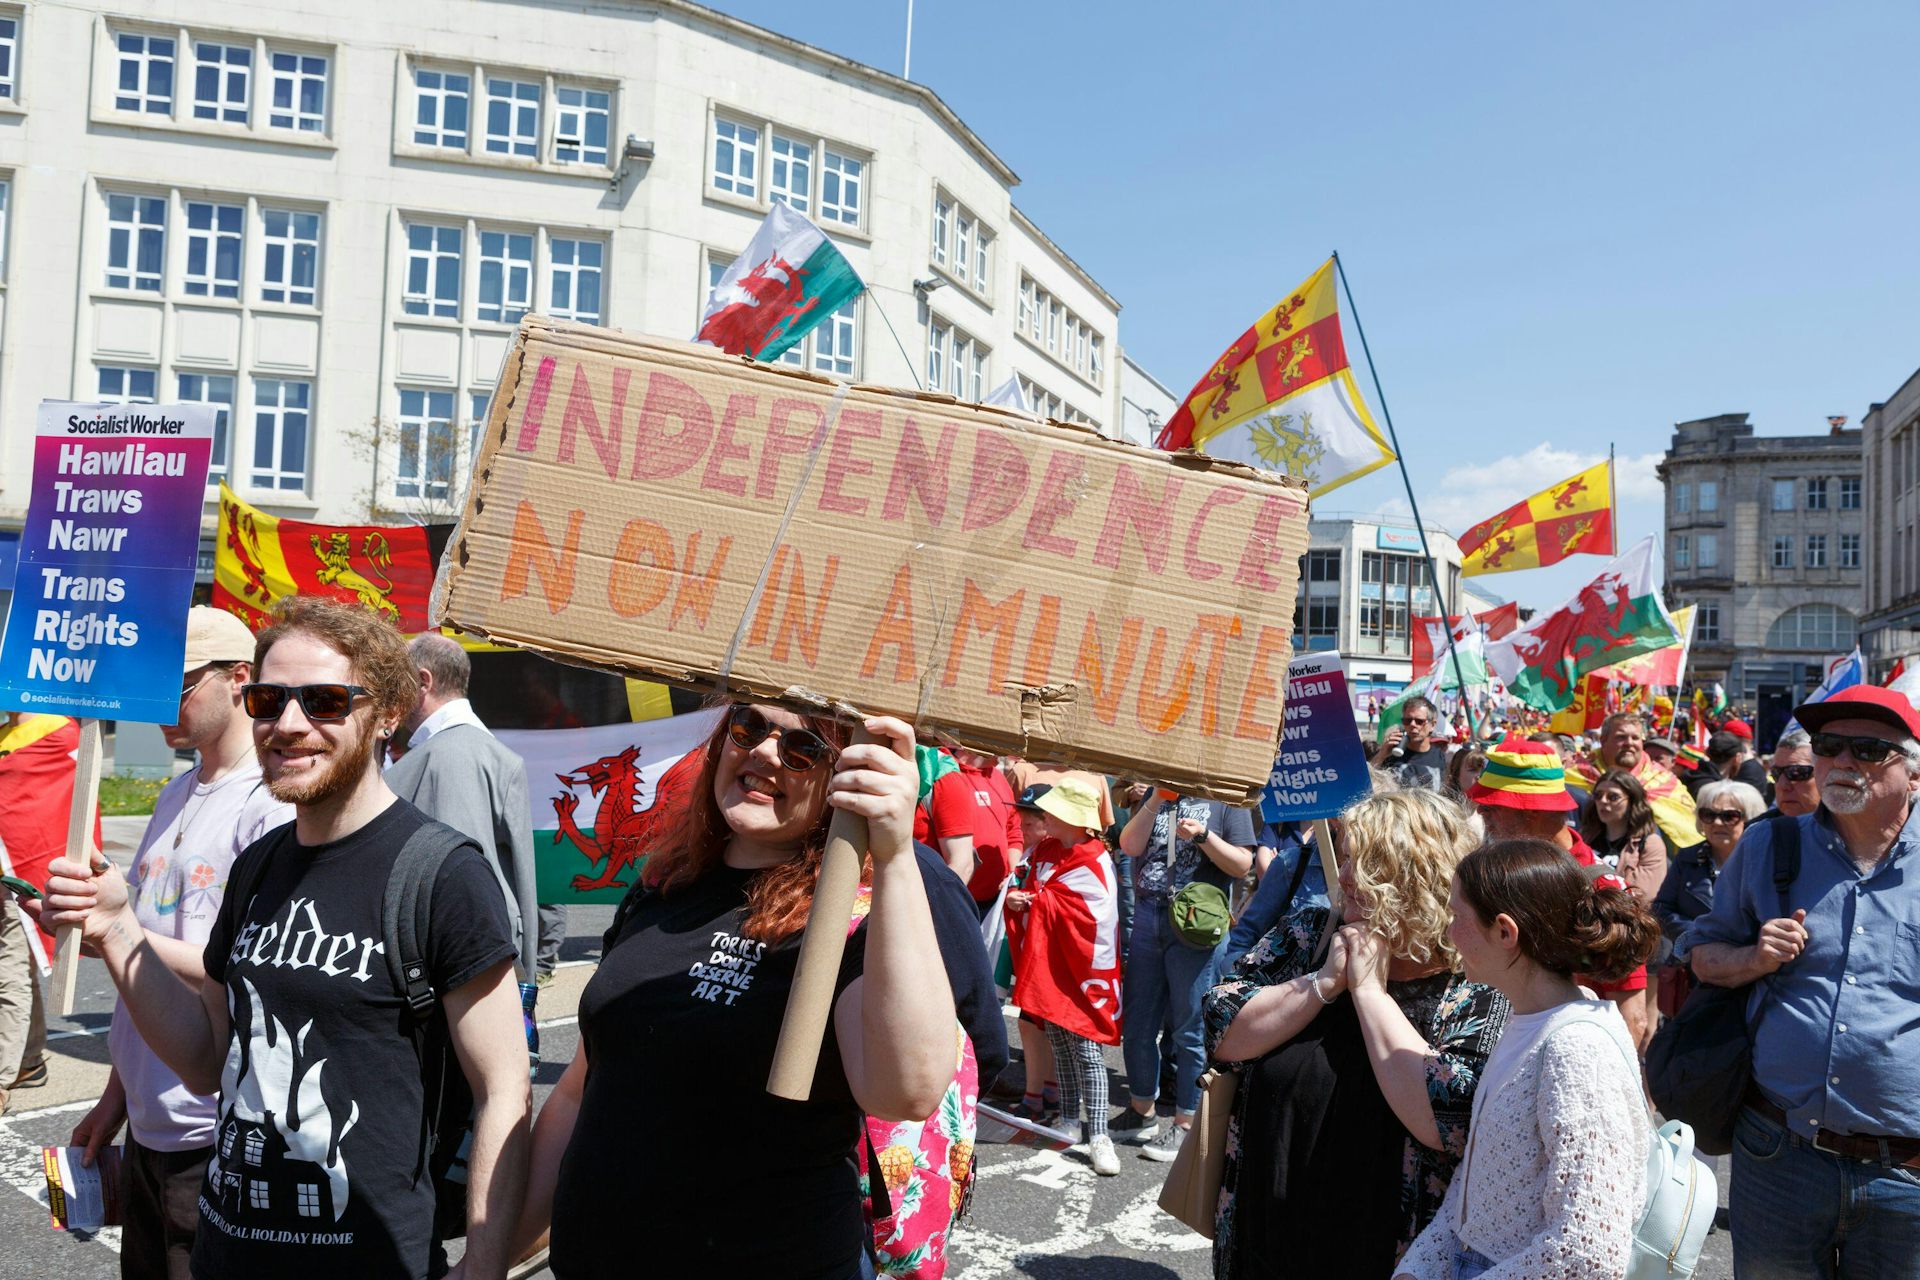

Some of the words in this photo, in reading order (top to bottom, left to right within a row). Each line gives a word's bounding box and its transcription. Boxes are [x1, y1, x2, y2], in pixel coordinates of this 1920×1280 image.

[58, 444, 186, 476] Hawliau
[515, 355, 1299, 593] INDEPENDENCE
[54, 482, 143, 514] Traws
[48, 519, 128, 552] Nawr
[41, 568, 126, 603] Trans
[33, 610, 139, 651] Rights
[500, 499, 734, 631] NOW
[746, 542, 840, 669] IN
[859, 561, 918, 684] A
[941, 577, 1287, 742] MINUTE
[27, 648, 96, 683] Now
[1270, 767, 1338, 789] Rights
[1273, 790, 1317, 806] Now
[228, 895, 384, 983] selder
[711, 932, 767, 962] TORIES
[688, 962, 754, 990] DESERVE
[709, 951, 757, 974] DON'T
[691, 981, 742, 1006] ART.
[221, 1220, 249, 1239] LOCAL
[251, 1228, 309, 1244] HOLIDAY
[312, 1232, 354, 1245] HOME
